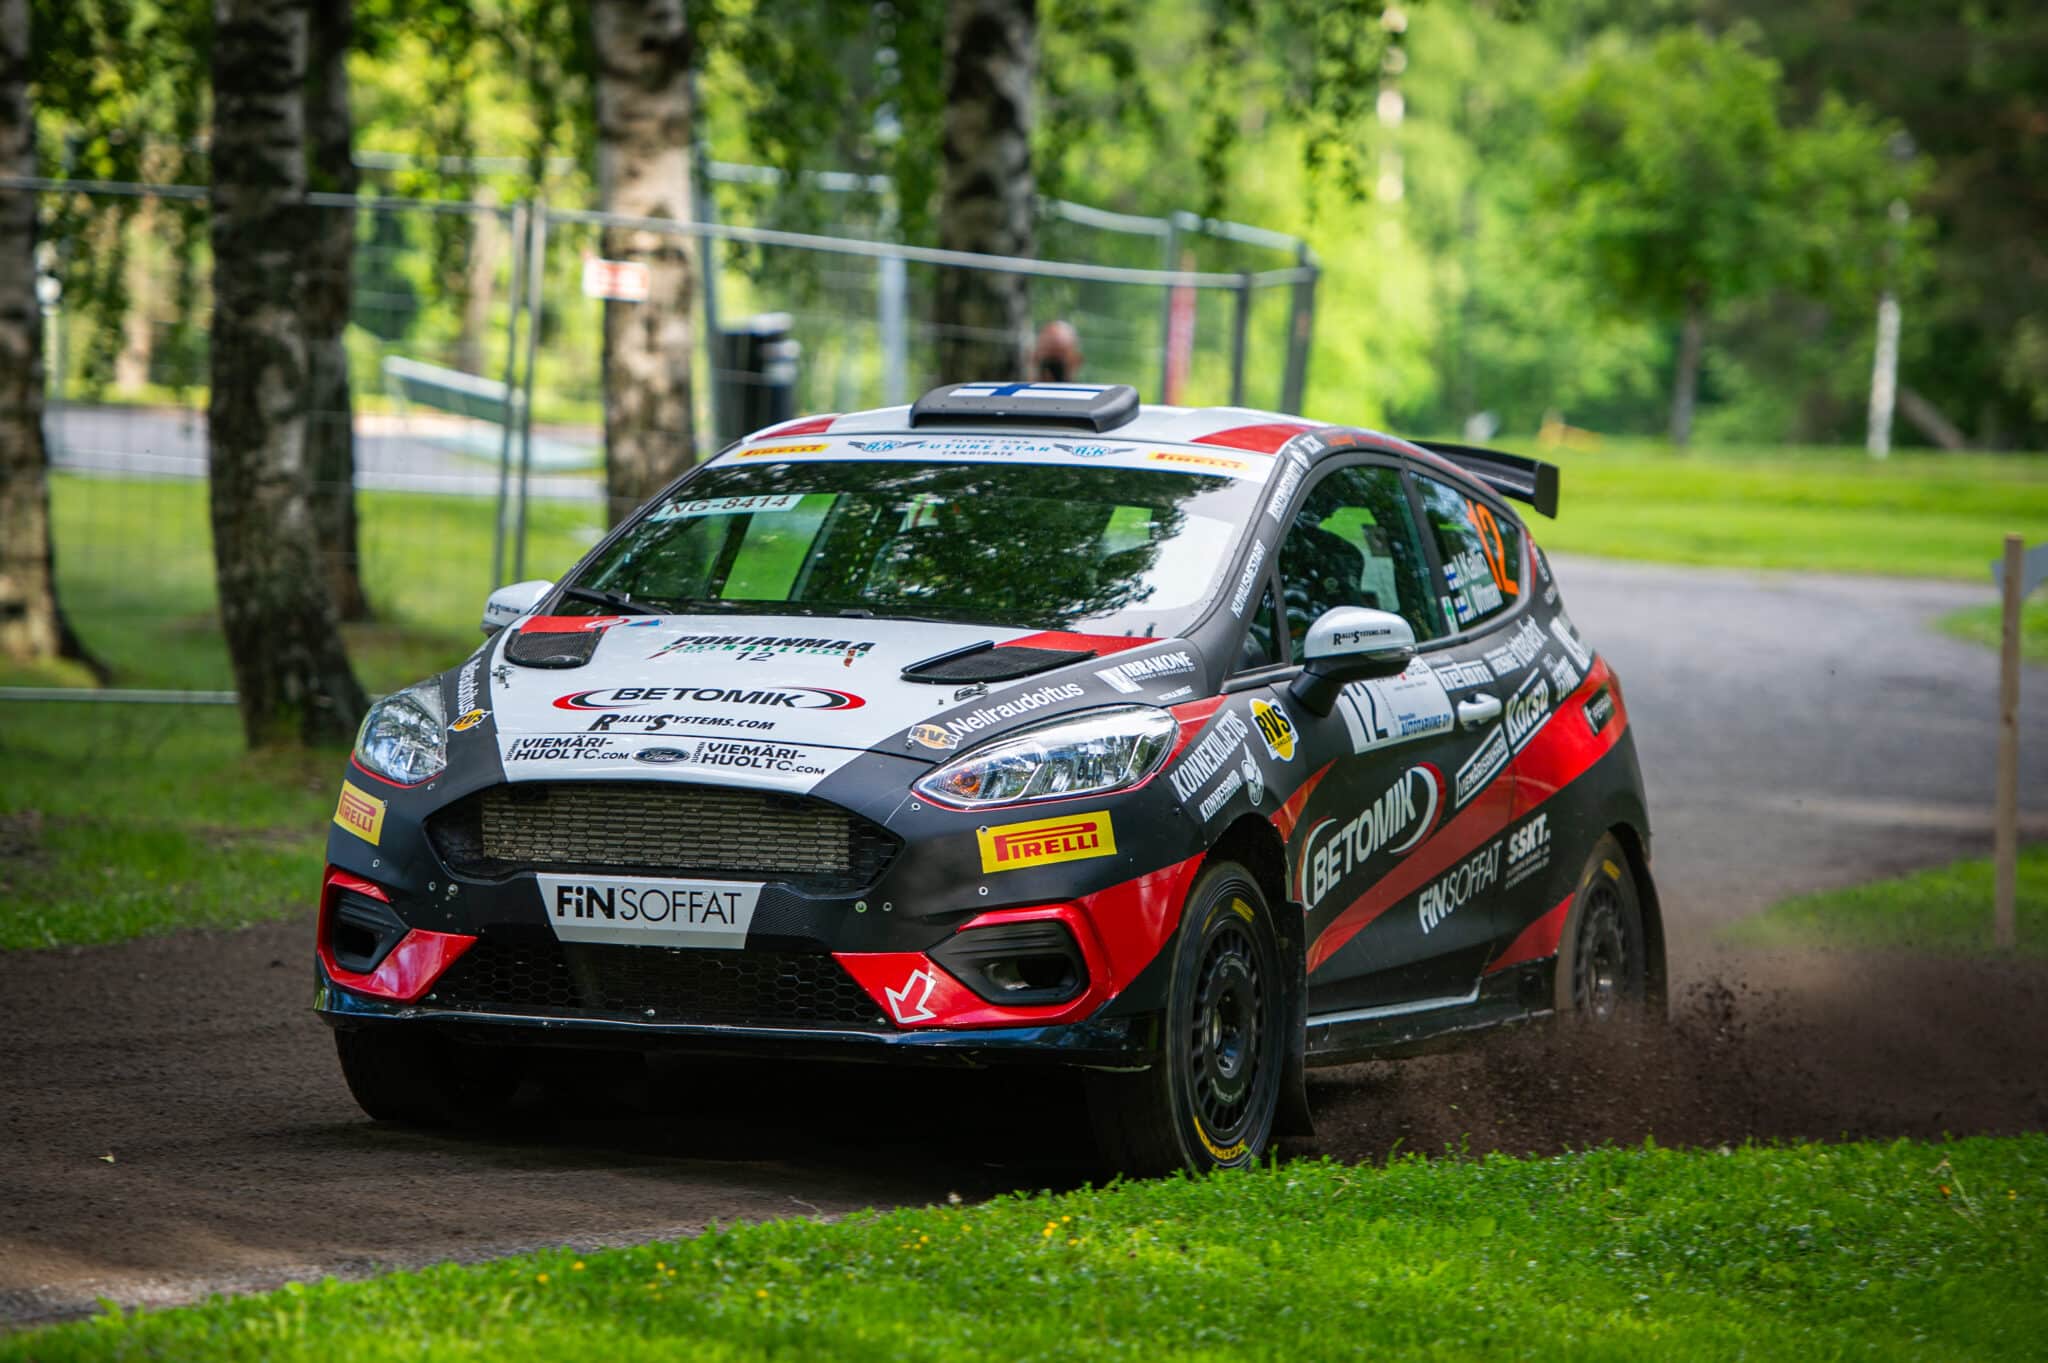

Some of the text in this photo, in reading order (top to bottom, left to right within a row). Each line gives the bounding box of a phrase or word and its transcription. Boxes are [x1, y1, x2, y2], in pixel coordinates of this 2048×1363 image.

[917, 443, 1051, 453] FUTURE STAR
[666, 496, 789, 515] NG-8414
[1466, 499, 1520, 595] 12
[735, 652, 775, 662] 12
[1093, 651, 1194, 694] VIBRAKONE
[611, 688, 805, 708] BETOMIK
[948, 682, 1084, 737] Neliraudoitus
[1342, 683, 1389, 742] 12
[522, 735, 614, 748] VIEMÄRI-
[1254, 704, 1292, 745] RVS
[708, 742, 807, 760] VIEMÄRI-
[339, 790, 377, 833] PIRELLI
[994, 822, 1099, 862] PIRELLI
[1314, 768, 1417, 906] BETOMIK
